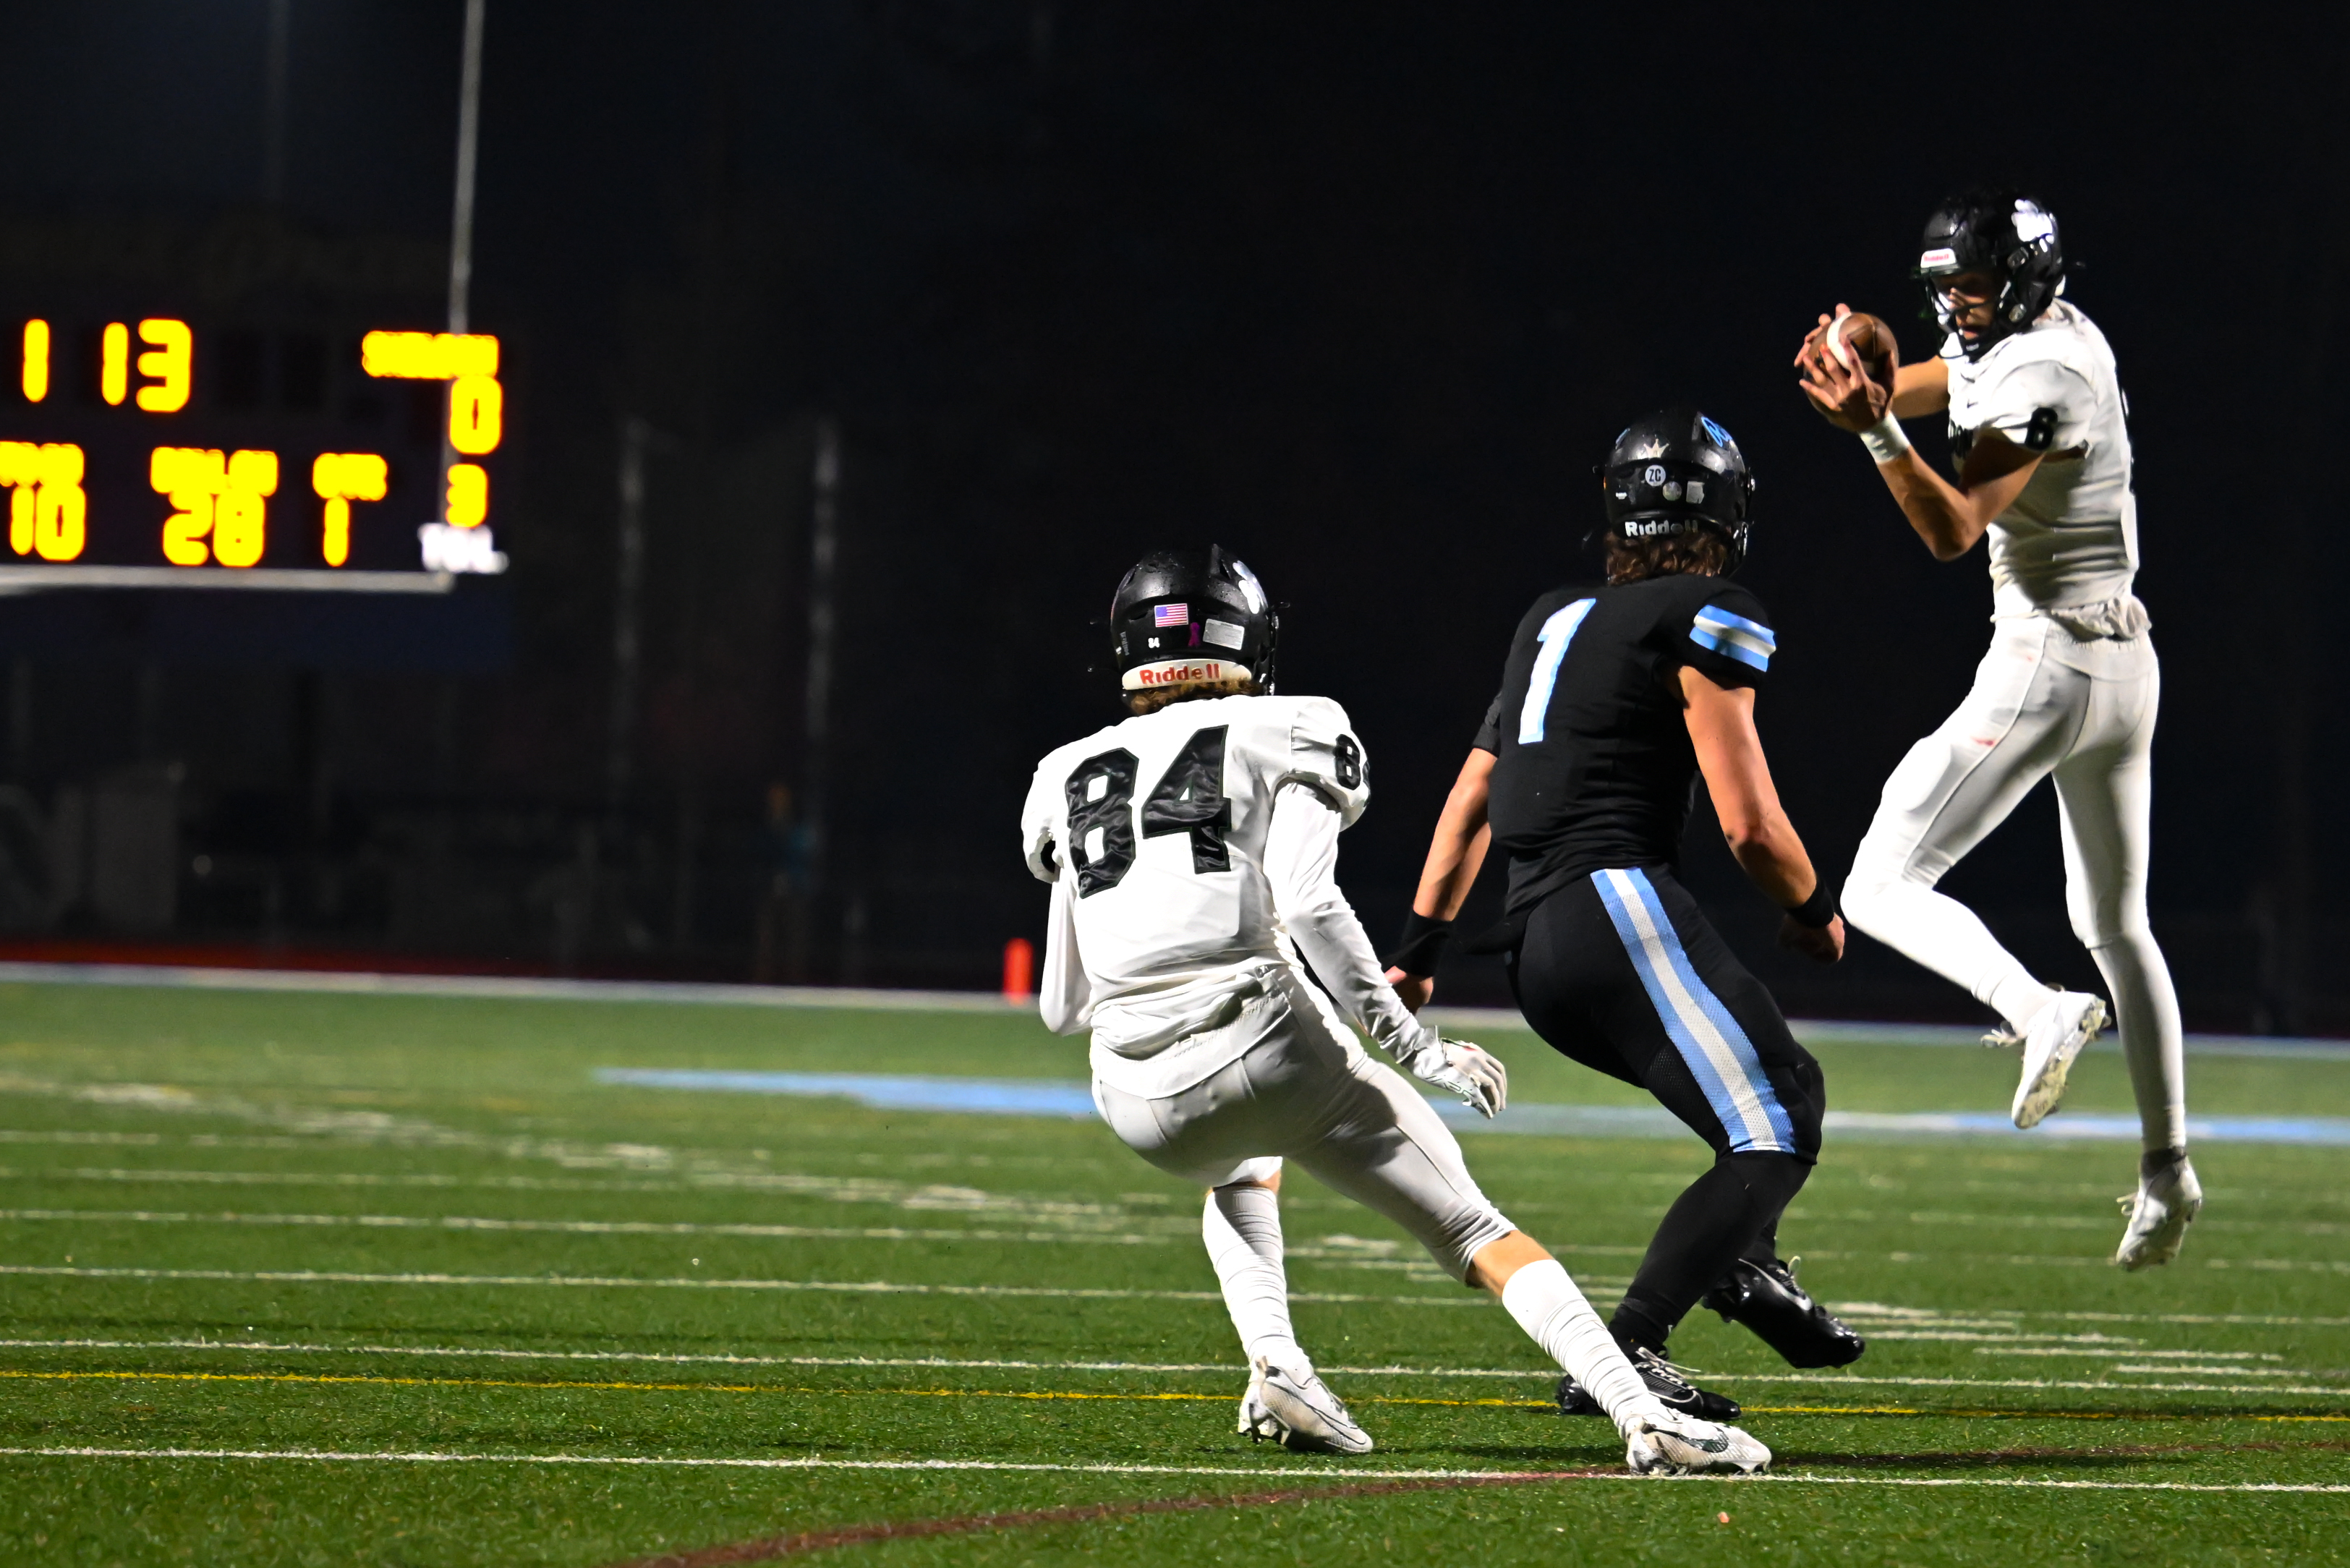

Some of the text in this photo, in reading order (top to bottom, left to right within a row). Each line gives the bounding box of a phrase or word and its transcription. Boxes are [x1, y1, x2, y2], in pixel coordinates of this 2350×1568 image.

[101, 319, 192, 412] 13
[449, 375, 502, 454] 0
[2025, 407, 2058, 450] 8
[446, 464, 488, 528] 3
[1649, 469, 1661, 482] ZC
[163, 492, 265, 567] 28
[1139, 663, 1220, 685] Riddell
[1148, 637, 1160, 649] 84
[1518, 598, 1596, 745] 1
[1065, 724, 1233, 900] 84
